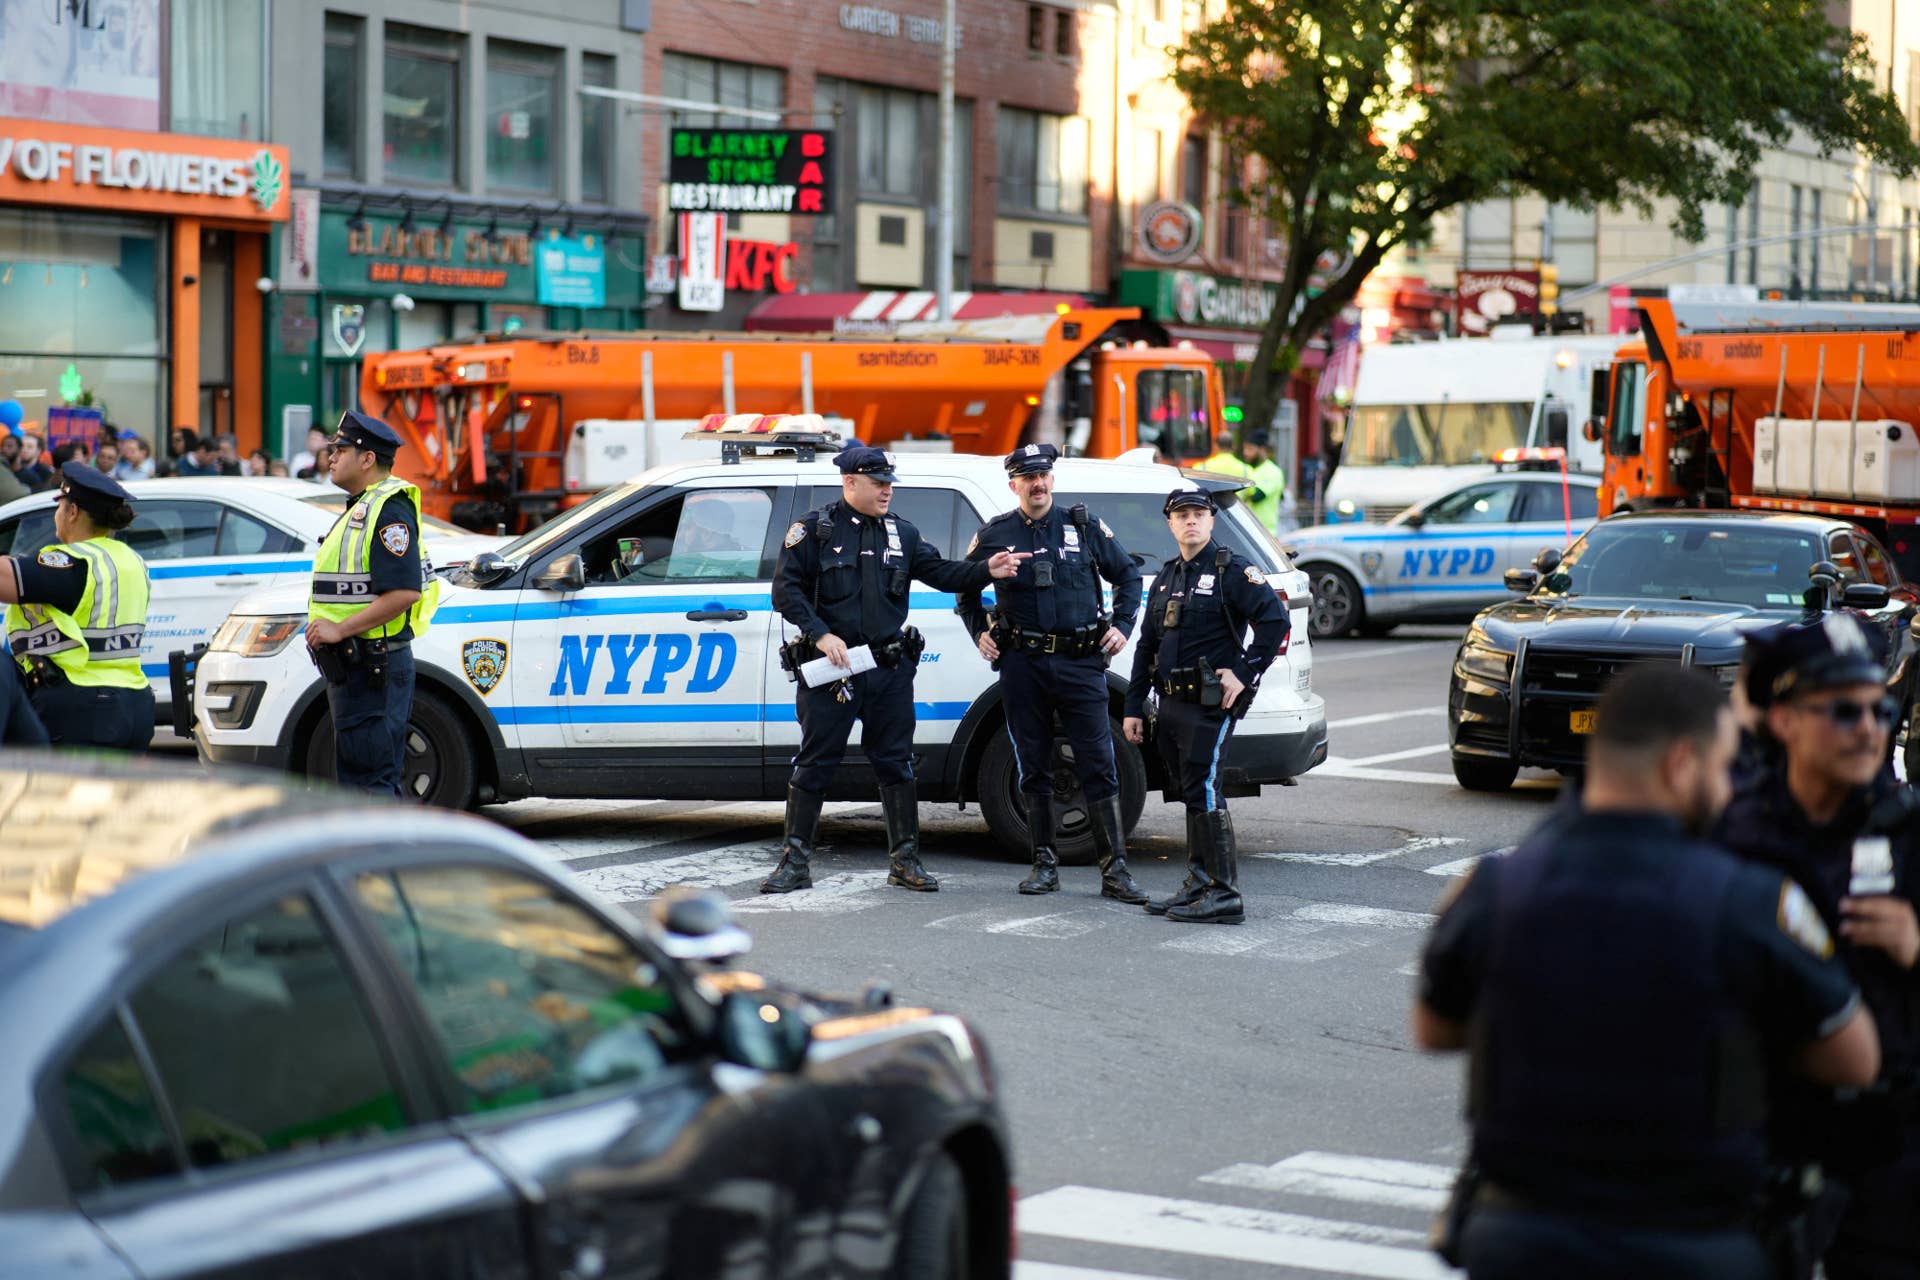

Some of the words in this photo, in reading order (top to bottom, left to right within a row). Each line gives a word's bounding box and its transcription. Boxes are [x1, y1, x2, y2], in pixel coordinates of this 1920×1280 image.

[673, 132, 788, 158] BLARNEY
[13, 139, 72, 182] OF
[75, 145, 252, 197] FLOWERS
[707, 160, 775, 183] STONE
[799, 133, 825, 212] BAR
[670, 183, 796, 211] RESTAURANT
[370, 263, 400, 281] BAR
[428, 267, 507, 288] RESTAURANT
[725, 238, 798, 293] KFC
[858, 350, 937, 367] sanitation
[1399, 547, 1495, 577] NYPD
[337, 582, 368, 595] PD
[27, 630, 61, 649] PD
[104, 633, 140, 651] NY
[472, 640, 497, 648] POLICE
[549, 633, 737, 696] NYPD
